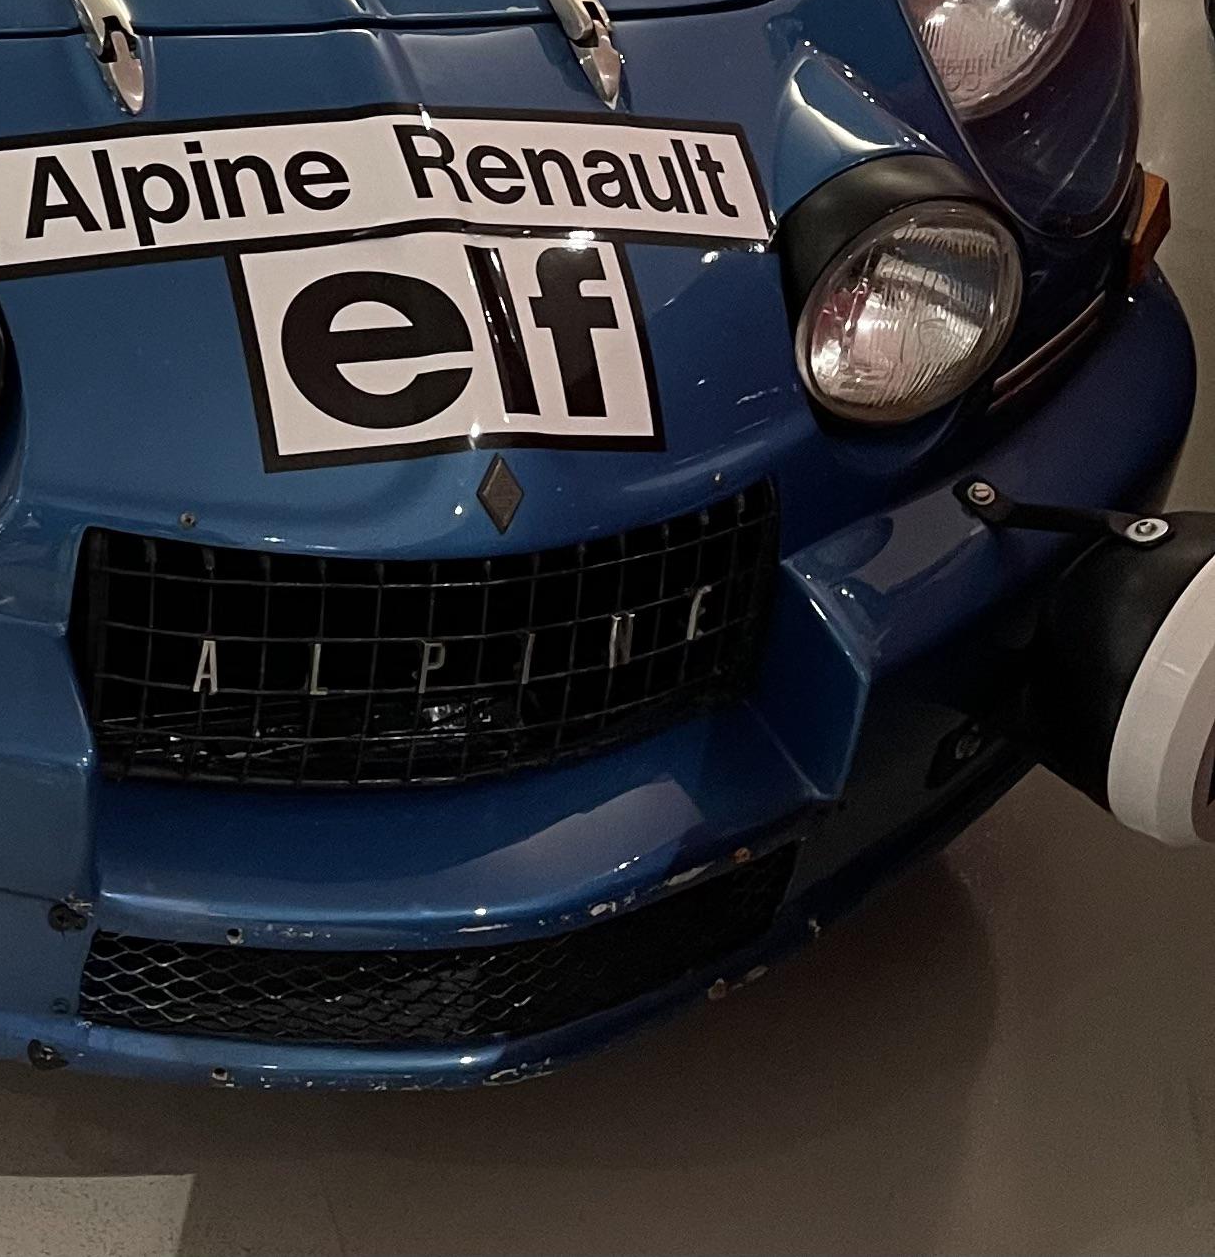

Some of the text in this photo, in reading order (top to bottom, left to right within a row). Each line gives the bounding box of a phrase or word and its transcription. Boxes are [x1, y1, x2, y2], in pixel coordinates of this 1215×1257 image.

[26, 124, 739, 247] Alpine Renault
[280, 244, 619, 430] elf
[192, 585, 713, 697] ALPINE
